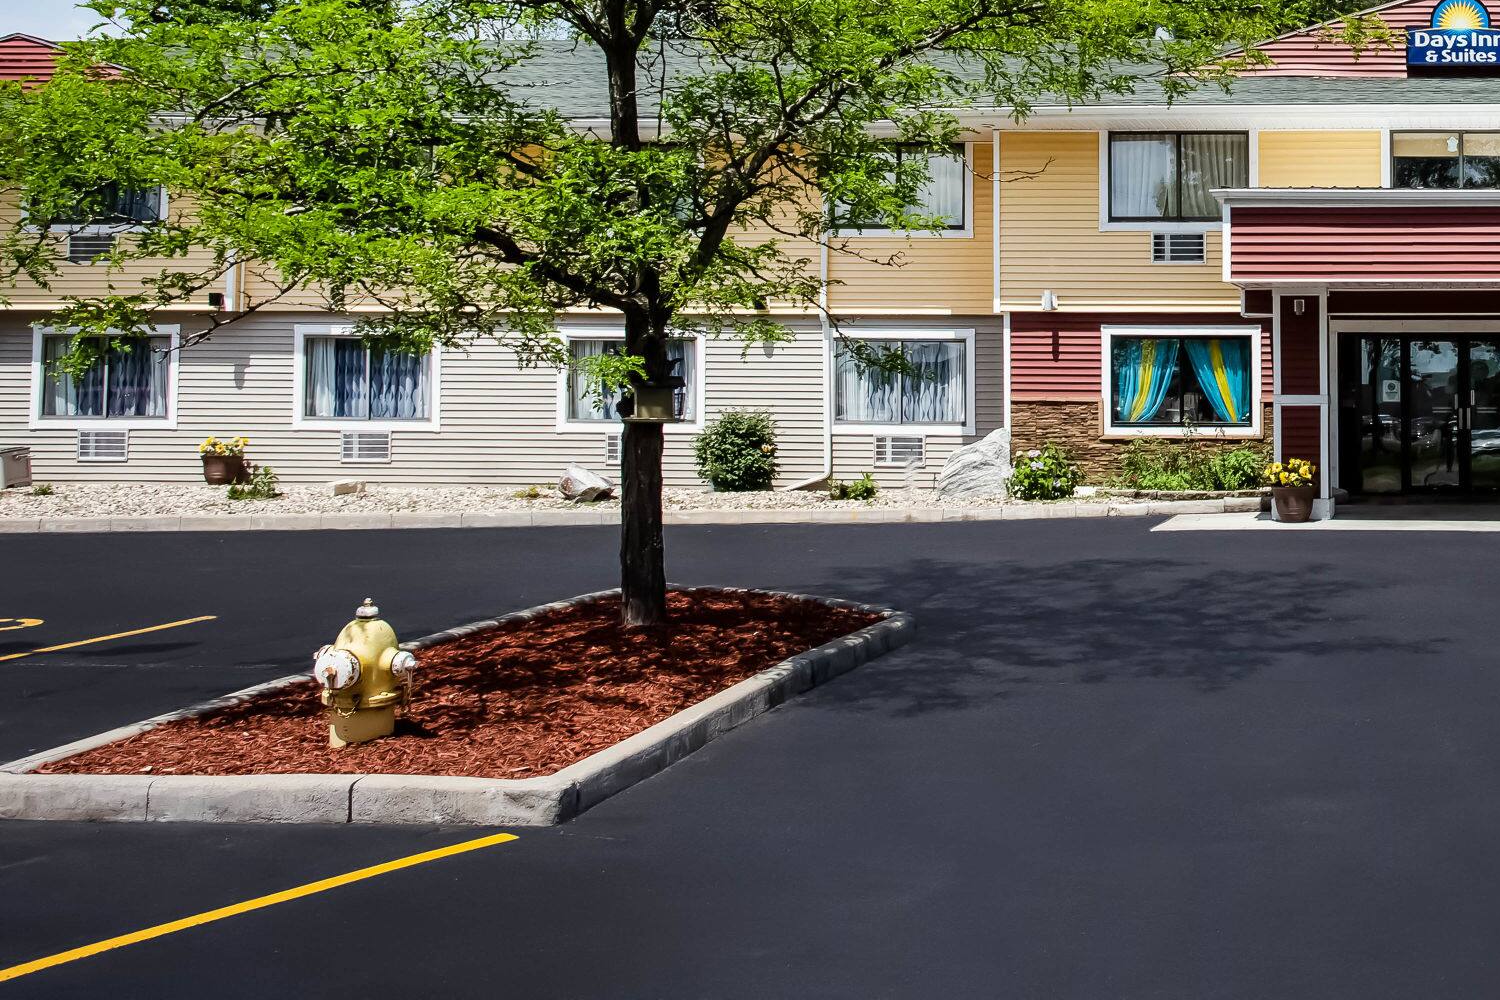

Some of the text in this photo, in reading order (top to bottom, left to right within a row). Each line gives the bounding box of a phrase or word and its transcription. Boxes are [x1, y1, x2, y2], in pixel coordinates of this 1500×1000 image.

[1414, 32, 1468, 49] Days
[1425, 49, 1497, 62] & Suites
